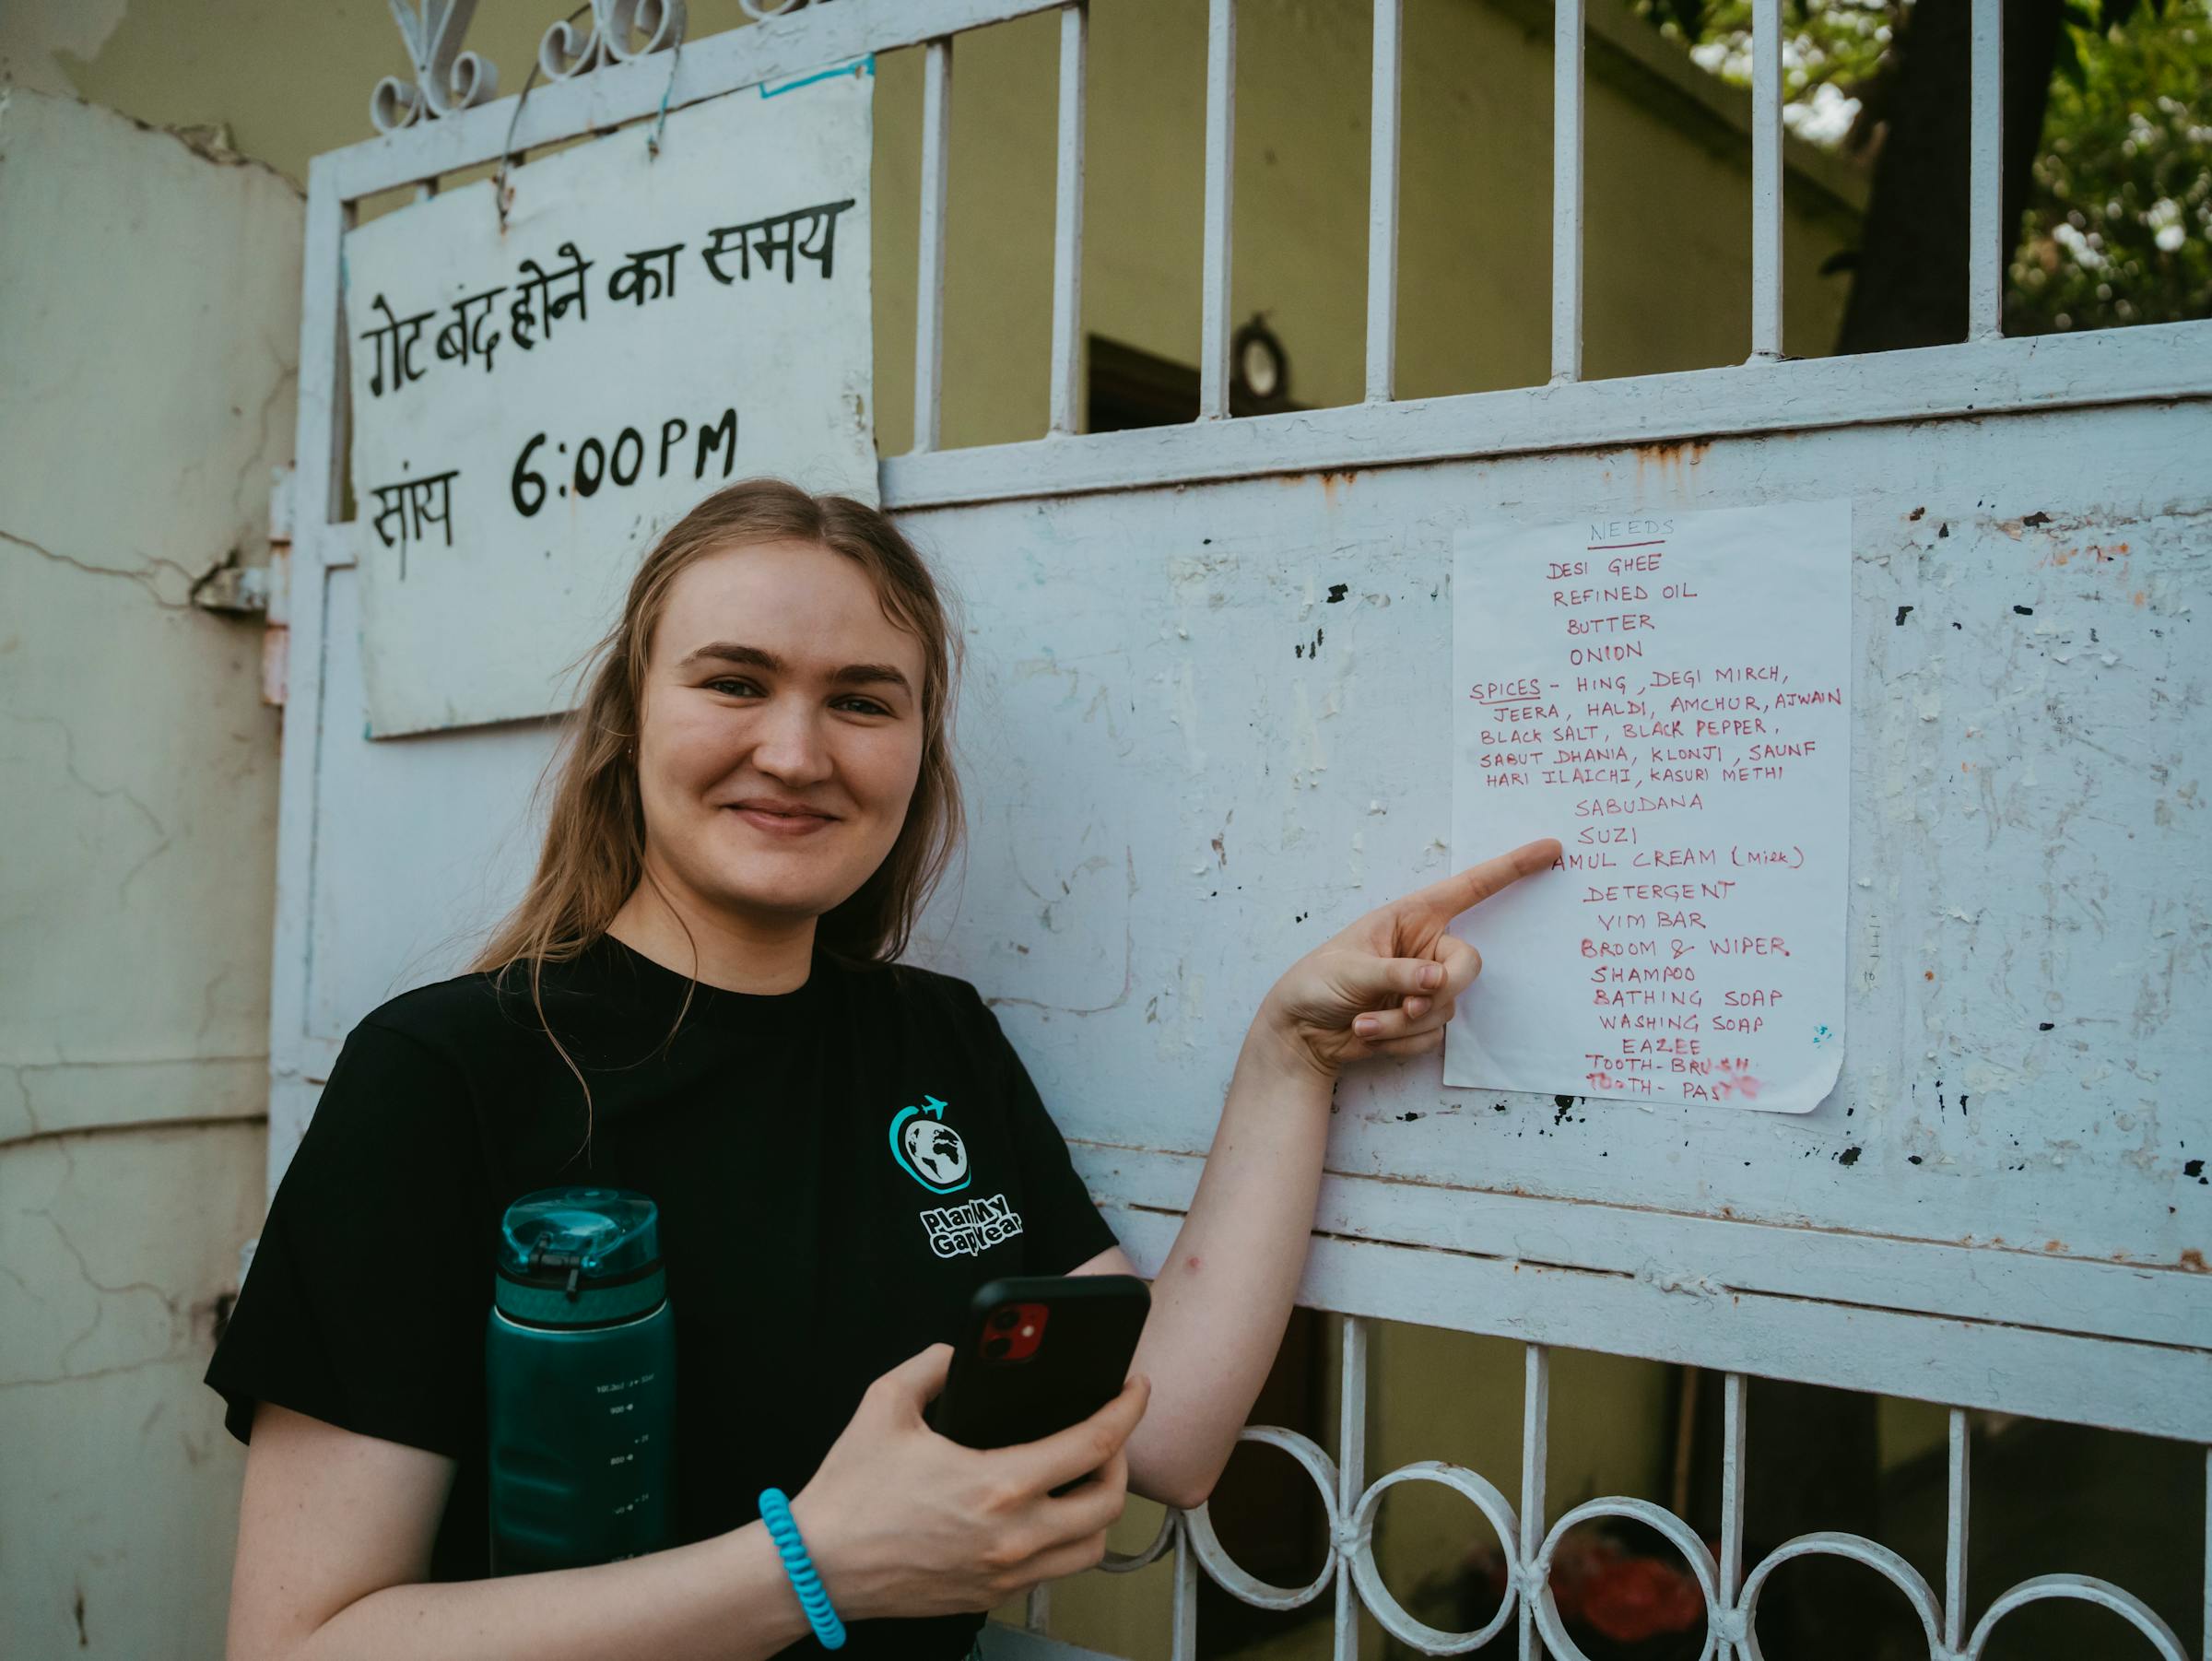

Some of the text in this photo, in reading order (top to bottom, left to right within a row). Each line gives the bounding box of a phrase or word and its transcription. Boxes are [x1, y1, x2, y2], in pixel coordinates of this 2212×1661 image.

[360, 198, 855, 397] गेट बंद होने का समय
[512, 427, 643, 517] 6:00
[659, 408, 737, 478] PM
[1590, 519, 1675, 541] NEEDS
[1547, 553, 1663, 580] DESI GHEE
[1553, 583, 1698, 607] REFINED OIL
[1567, 614, 1655, 635] BUTTER
[1571, 642, 1643, 666] ONION
[1469, 678, 1541, 700] SPICES
[1650, 670, 1700, 689] DEGI
[1715, 666, 1788, 685] MIRCH,
[1670, 696, 1769, 713] AMCHUR,
[1775, 688, 1841, 709] AJWAIN
[1480, 729, 1542, 745] BLACK
[1623, 720, 1684, 738] BLACK
[1480, 752, 1543, 768] SABUT
[1553, 746, 1637, 766] DHANIA,
[1749, 741, 1816, 761] SAUNF
[1487, 772, 1528, 788] HARI
[1650, 767, 1709, 783] KASURI
[1723, 766, 1783, 782] METHI
[1575, 794, 1703, 818] SABUDANA
[1577, 827, 1637, 844] SUZI
[1551, 853, 1617, 871] AMUL
[1632, 848, 1716, 867] CREAM
[1583, 880, 1736, 902] DETERGENT
[1598, 911, 1706, 931] VIM BAR
[1581, 938, 1657, 959] BROOM
[1671, 938, 1695, 960] &
[1590, 966, 1696, 984] SHAMPOO
[1593, 989, 1783, 1007] BATHING SOAP
[1599, 1014, 1764, 1033] WASHING SOAP
[1622, 1038, 1701, 1054] EAZEE
